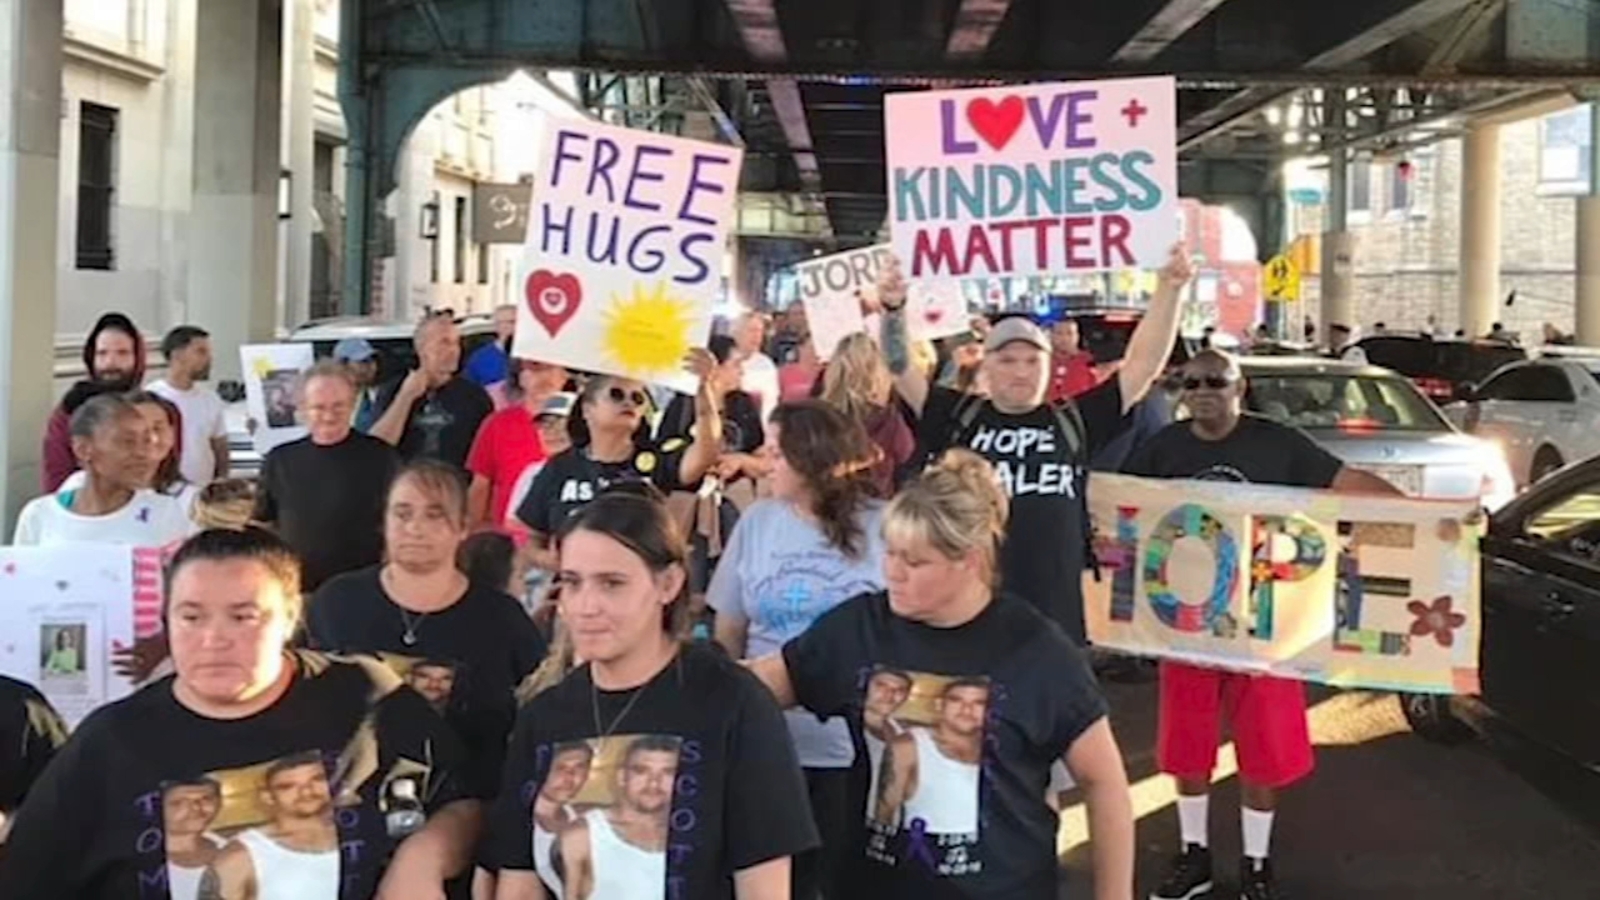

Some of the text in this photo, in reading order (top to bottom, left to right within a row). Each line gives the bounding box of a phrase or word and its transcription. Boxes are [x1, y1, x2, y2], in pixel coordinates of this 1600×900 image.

[551, 130, 730, 225] FREE
[894, 150, 1162, 221] KINDNESS
[541, 203, 714, 283] HUGS
[912, 215, 1136, 277] MATTER
[970, 425, 1055, 458] HOPE
